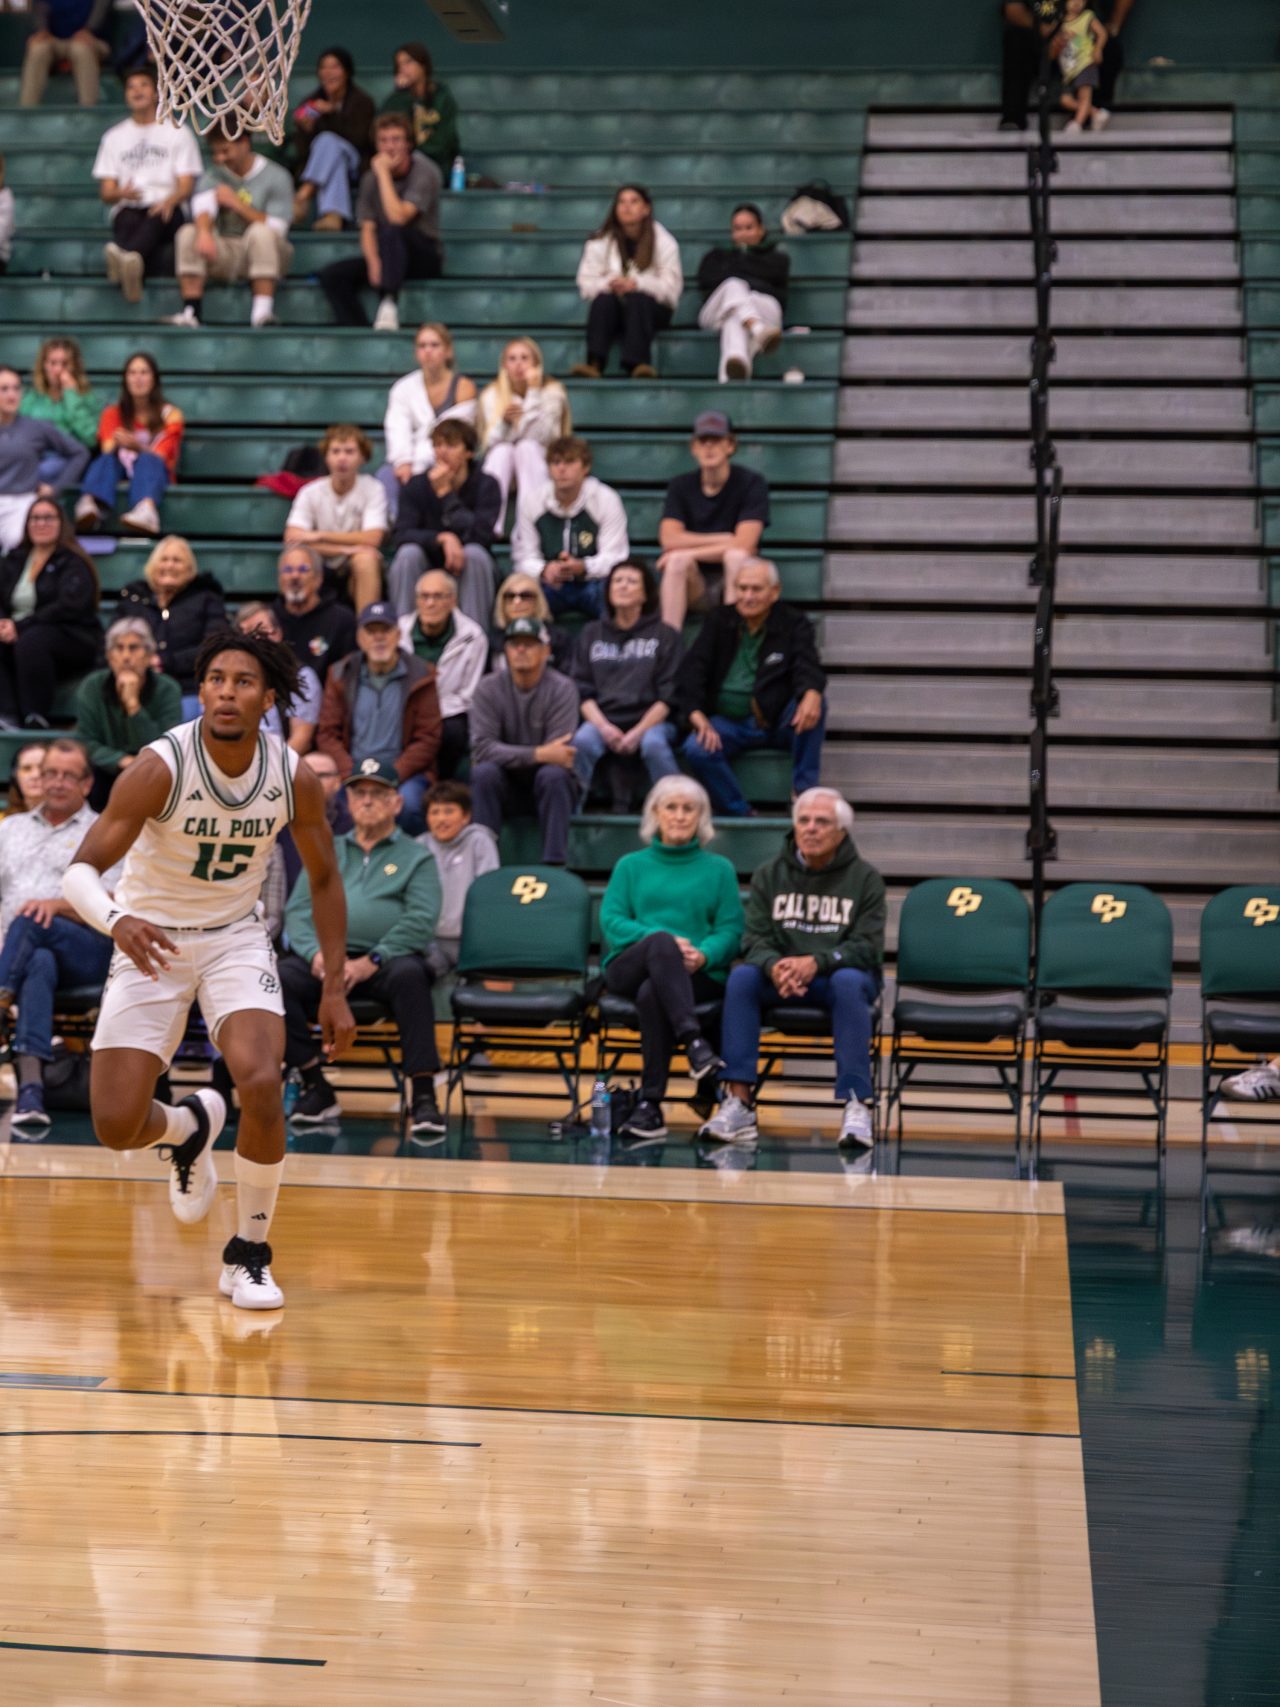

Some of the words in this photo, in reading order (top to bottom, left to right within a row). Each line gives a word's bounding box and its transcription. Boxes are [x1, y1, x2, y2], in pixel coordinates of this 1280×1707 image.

[183, 817, 220, 837] CAL
[229, 817, 277, 838] POLY
[190, 842, 257, 881] 15
[772, 892, 805, 921] CAL
[806, 894, 854, 926] POLY
